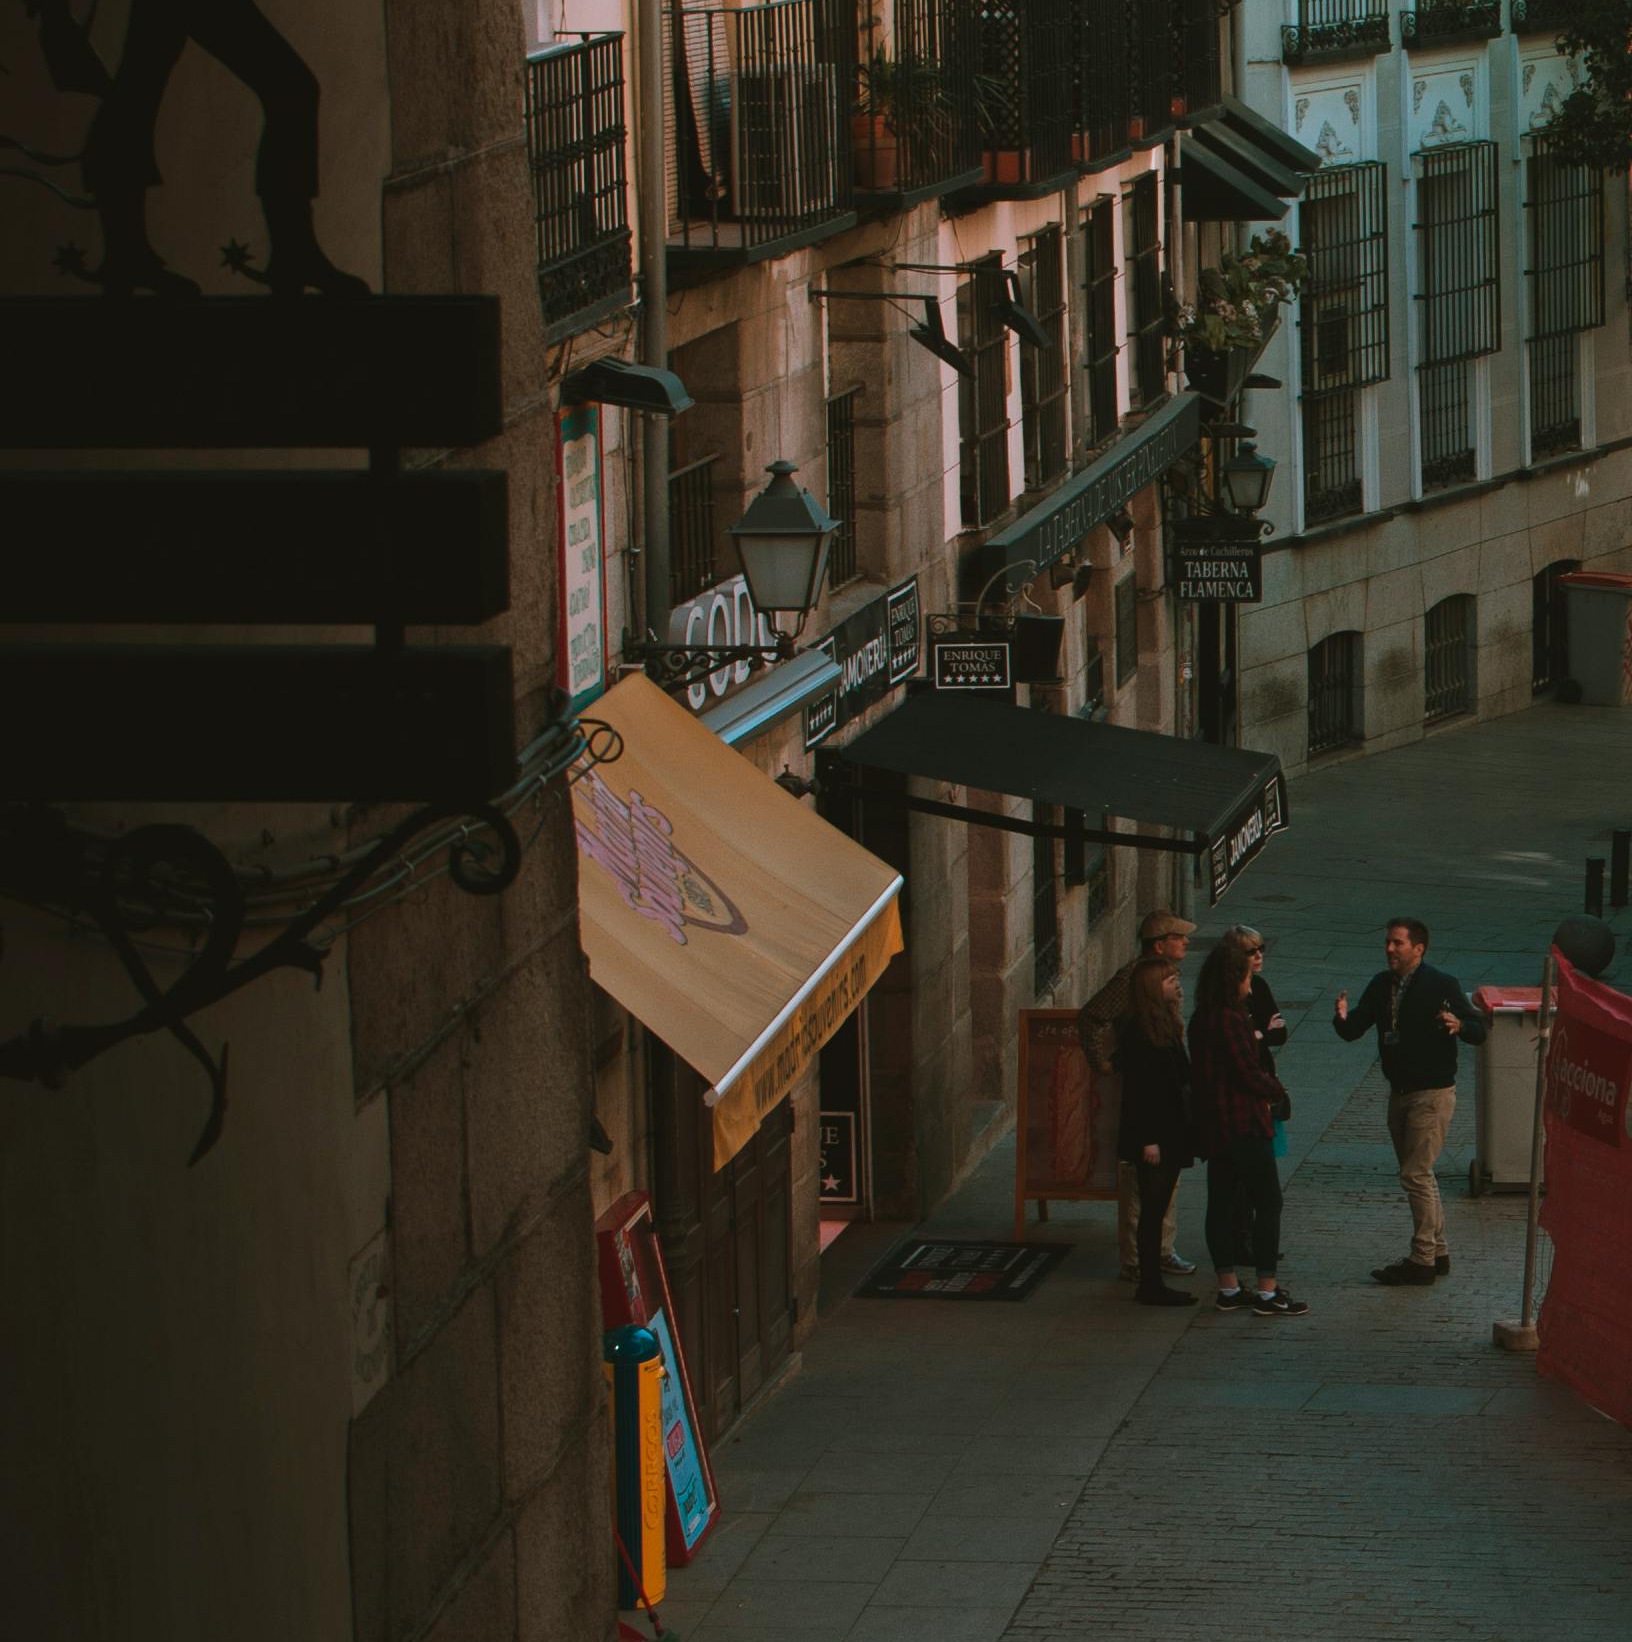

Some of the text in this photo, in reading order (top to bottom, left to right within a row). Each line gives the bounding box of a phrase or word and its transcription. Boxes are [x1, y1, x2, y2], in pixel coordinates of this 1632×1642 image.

[1183, 560, 1249, 578] TABERNA
[1180, 580, 1254, 598] FLAMENCA
[943, 649, 1003, 663] ENRIQUE
[1560, 1057, 1617, 1107] acciona
